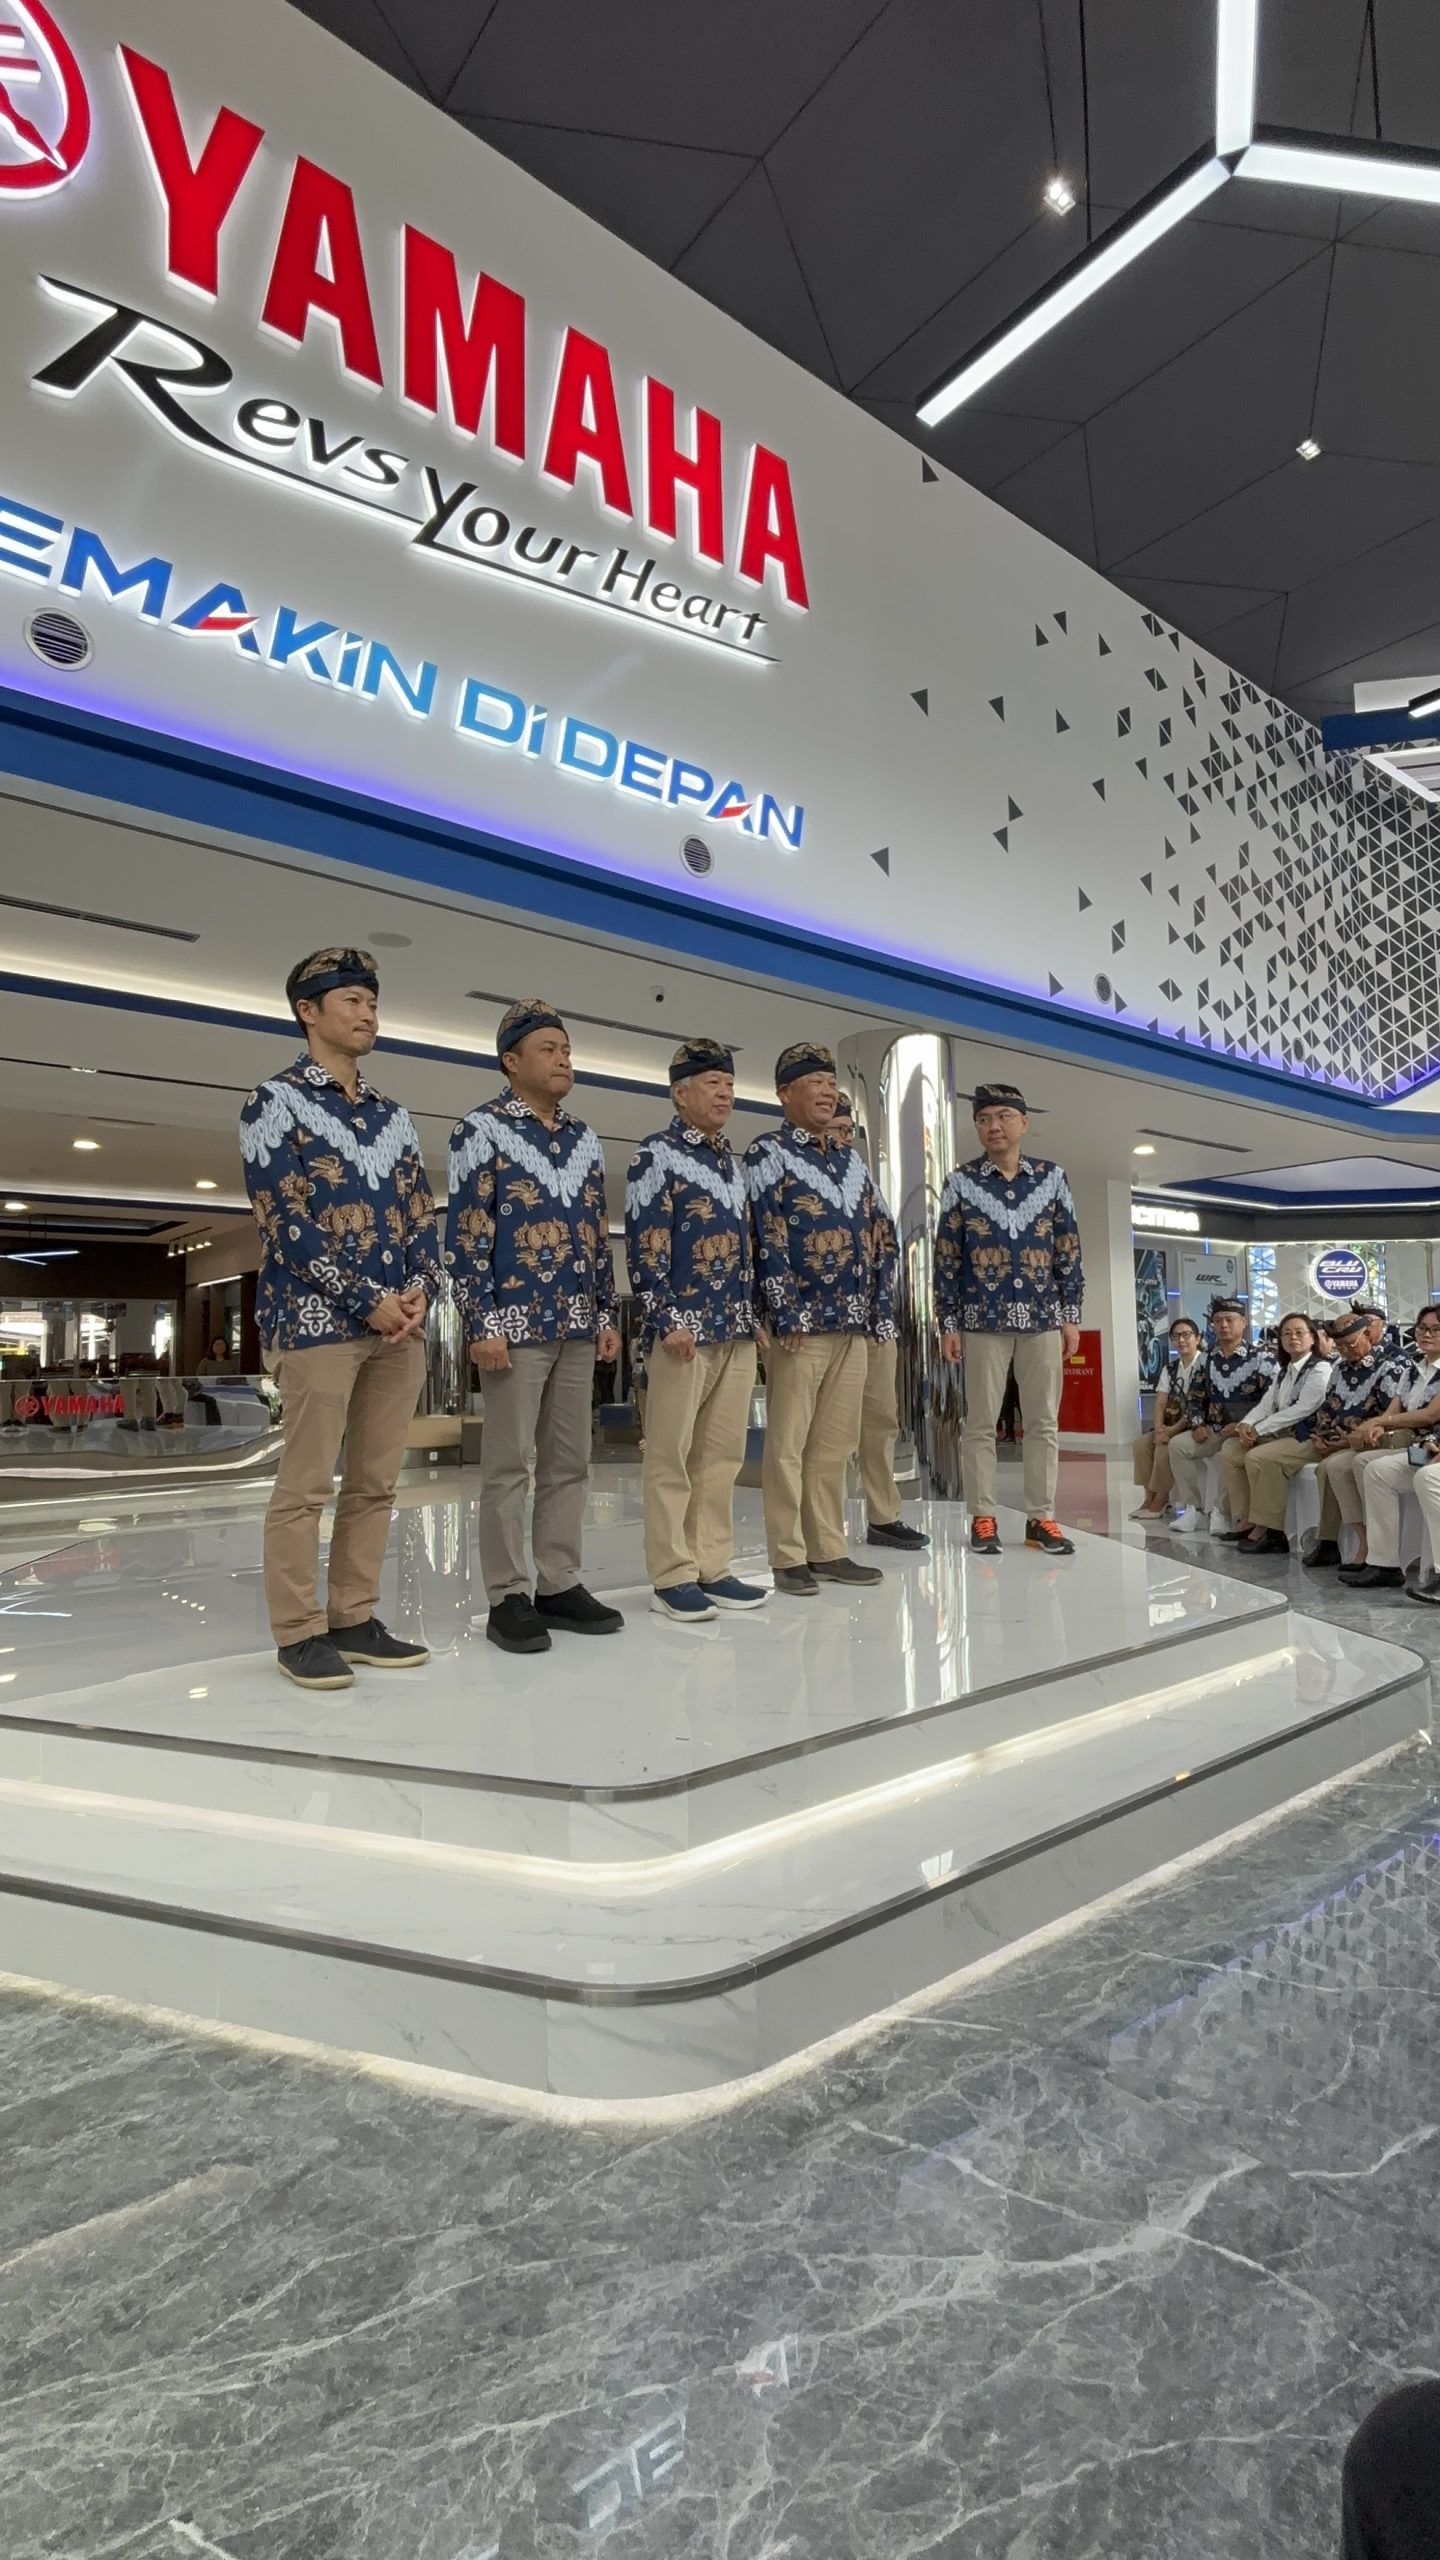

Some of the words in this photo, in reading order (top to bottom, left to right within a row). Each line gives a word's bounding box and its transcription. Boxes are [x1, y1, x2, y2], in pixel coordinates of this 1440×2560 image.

[116, 43, 811, 614] YAMAHA
[32, 273, 412, 502] Revs
[412, 466, 599, 578] Your
[601, 547, 768, 642] Heart
[555, 716, 805, 851] DEPAN
[41, 1394, 125, 1415] YAMAHA
